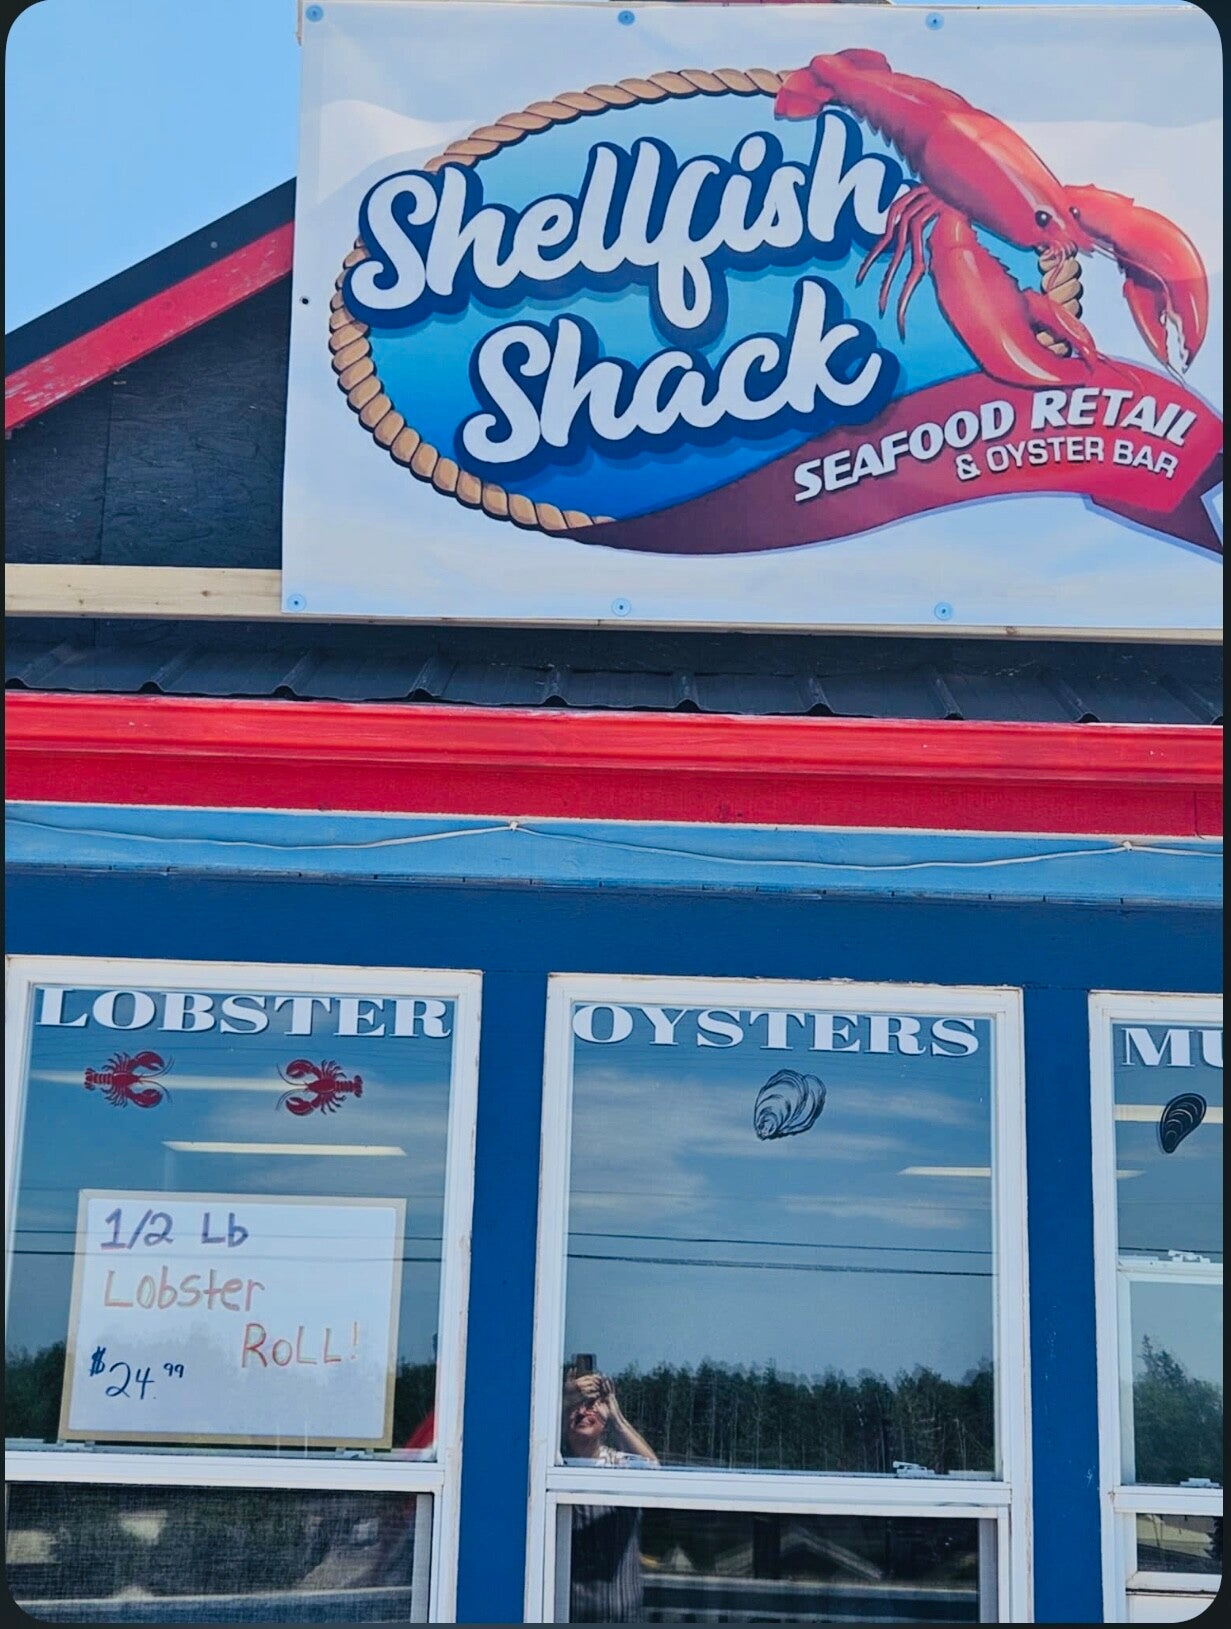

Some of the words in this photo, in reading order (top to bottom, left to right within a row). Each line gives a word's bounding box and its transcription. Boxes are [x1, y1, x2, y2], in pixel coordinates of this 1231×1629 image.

[350, 109, 908, 331] Shellfish
[461, 279, 885, 465] Shack
[794, 400, 1015, 502] SEAFOOD
[1031, 388, 1198, 446] RETAIL
[955, 454, 981, 481] &
[985, 436, 1105, 471] OYSTER
[1112, 439, 1179, 479] BAR
[35, 987, 452, 1037] LOBSTER
[571, 1004, 979, 1057] OYSTERS
[100, 1208, 174, 1250] 1/2
[201, 1212, 249, 1249] Lb
[104, 1266, 265, 1312] Lobster
